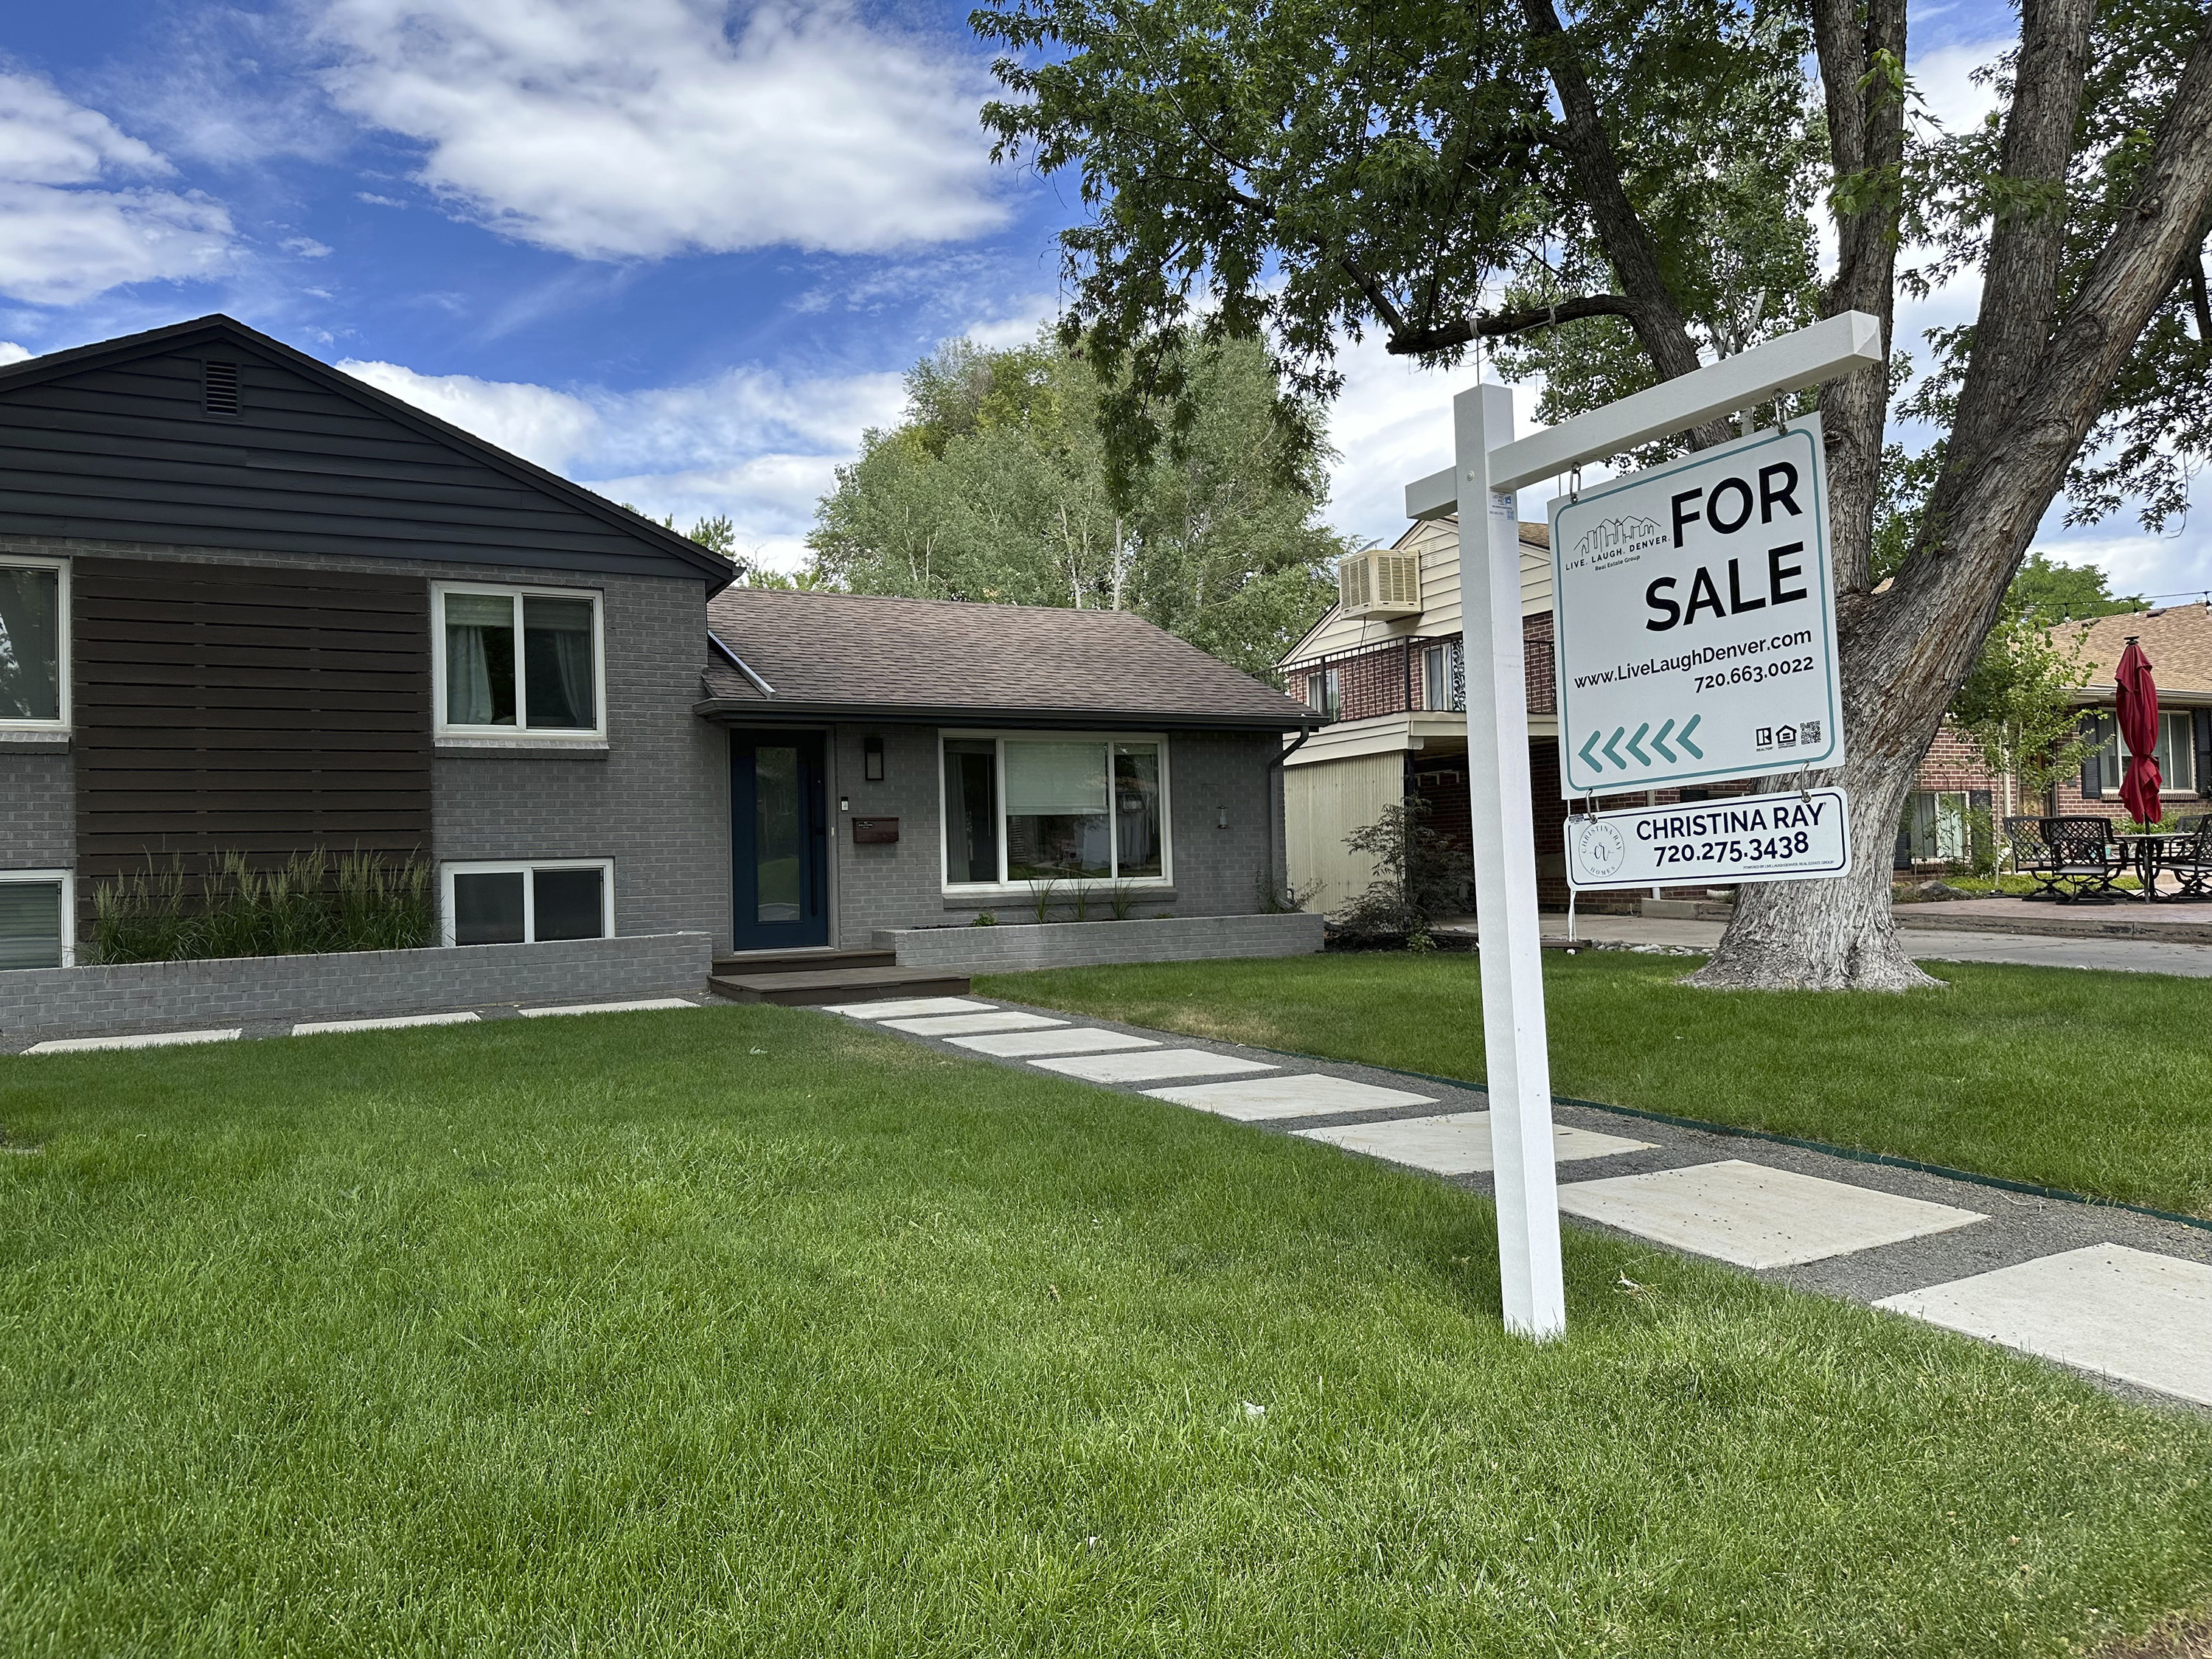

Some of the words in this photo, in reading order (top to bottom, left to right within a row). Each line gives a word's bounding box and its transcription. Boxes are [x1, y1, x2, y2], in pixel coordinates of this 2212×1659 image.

[1671, 461, 1804, 549] FOR
[1565, 559, 1588, 571] LIVE.
[1591, 548, 1626, 563] LAUGH.
[1629, 535, 1671, 552] DENVER.
[1607, 560, 1624, 568] Estate
[1624, 554, 1641, 563] Group
[1645, 540, 1808, 632] SALE
[1573, 630, 1812, 689] www.LiveLaughDenver.com
[1694, 656, 1815, 693] 720.663.0022
[1582, 825, 1613, 854] CHRISTINA
[1613, 835, 1622, 851] RAY
[1636, 808, 1767, 841] CHRISTINA
[1773, 802, 1826, 830] RAY
[1653, 831, 1809, 866] 720.275.3438
[1590, 865, 1615, 875] HOMES
